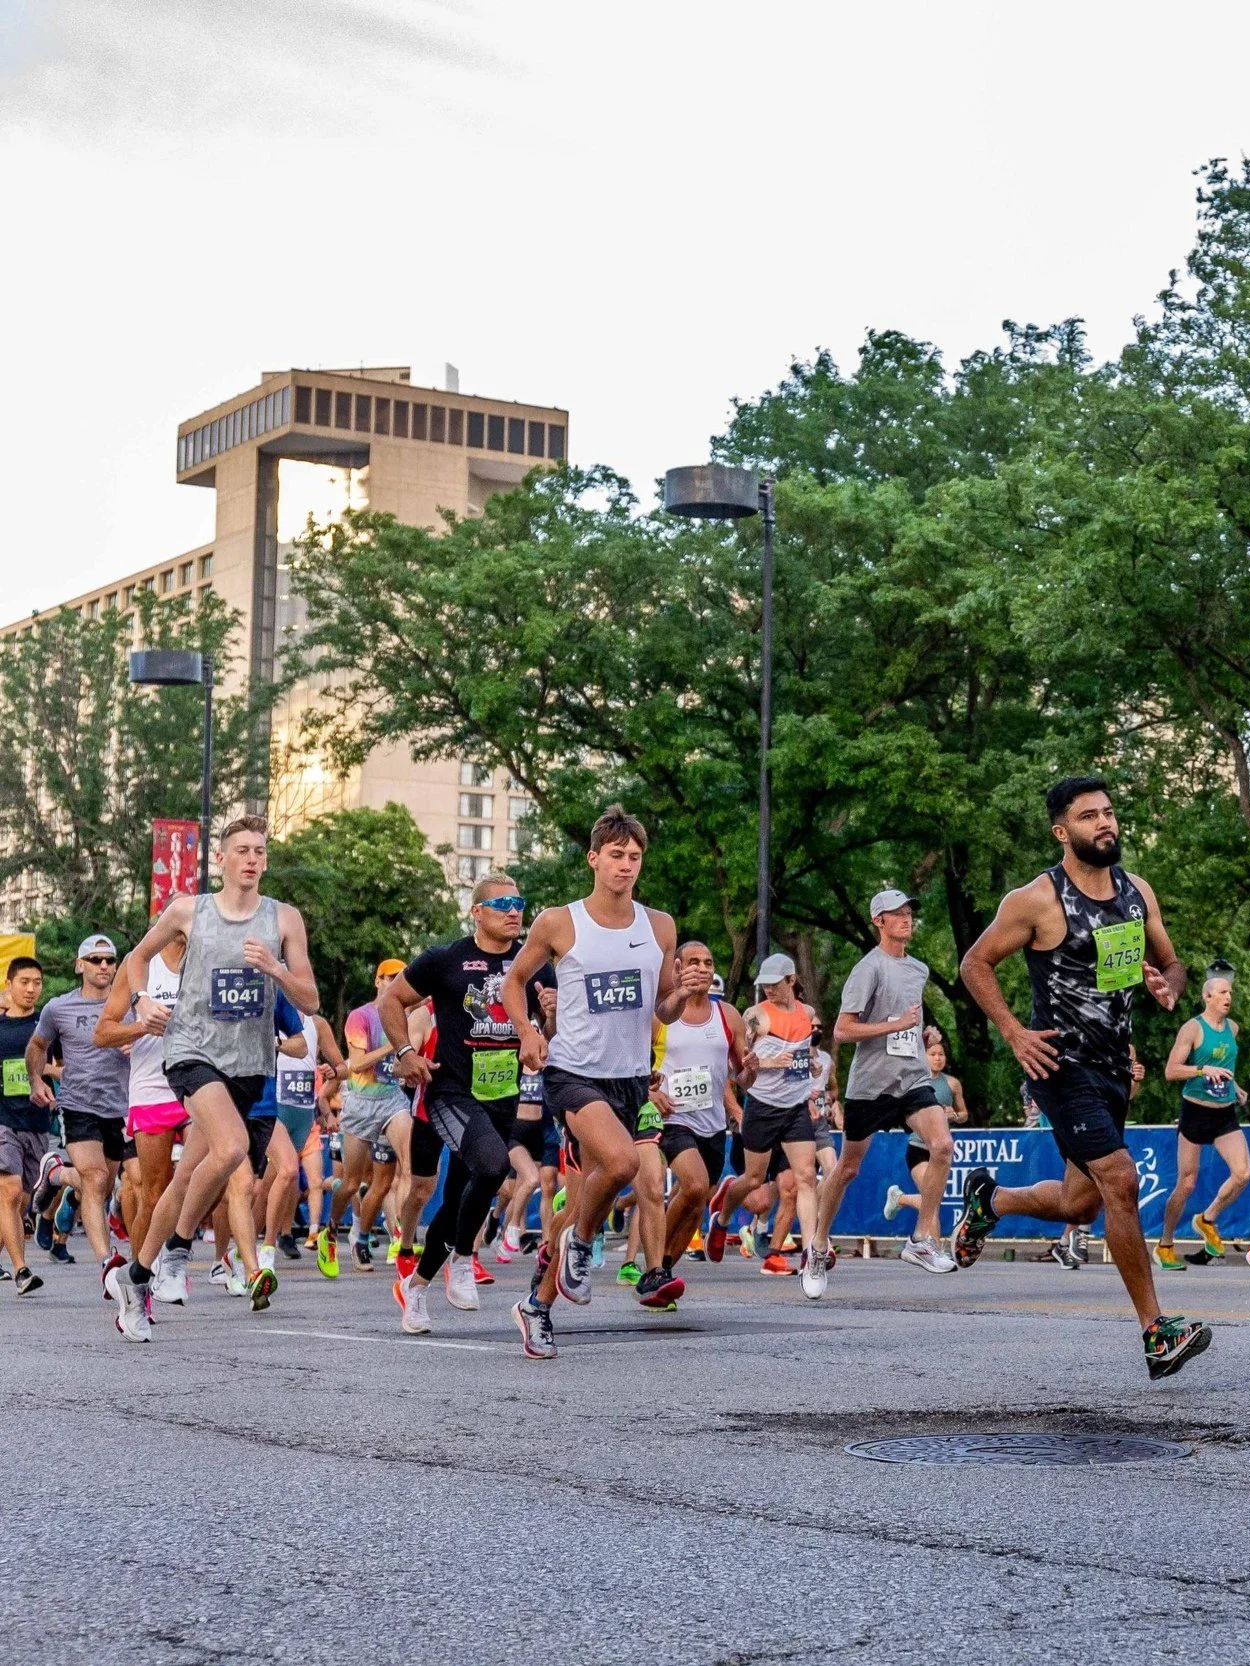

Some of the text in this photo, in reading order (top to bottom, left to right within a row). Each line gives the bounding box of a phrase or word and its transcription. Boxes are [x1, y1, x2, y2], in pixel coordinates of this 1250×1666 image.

[1103, 946, 1141, 969] 4753
[218, 988, 258, 1004] 1041
[593, 986, 637, 1005] 1475
[473, 1021, 516, 1036] JPA ROOF
[382, 1061, 394, 1073] 70
[789, 1058, 809, 1070] 066
[8, 1073, 29, 1082] 418
[477, 1069, 514, 1084] 4752
[287, 1081, 312, 1093] 488
[674, 1083, 708, 1098] 3219
[952, 1138, 1024, 1163] SPITAL
